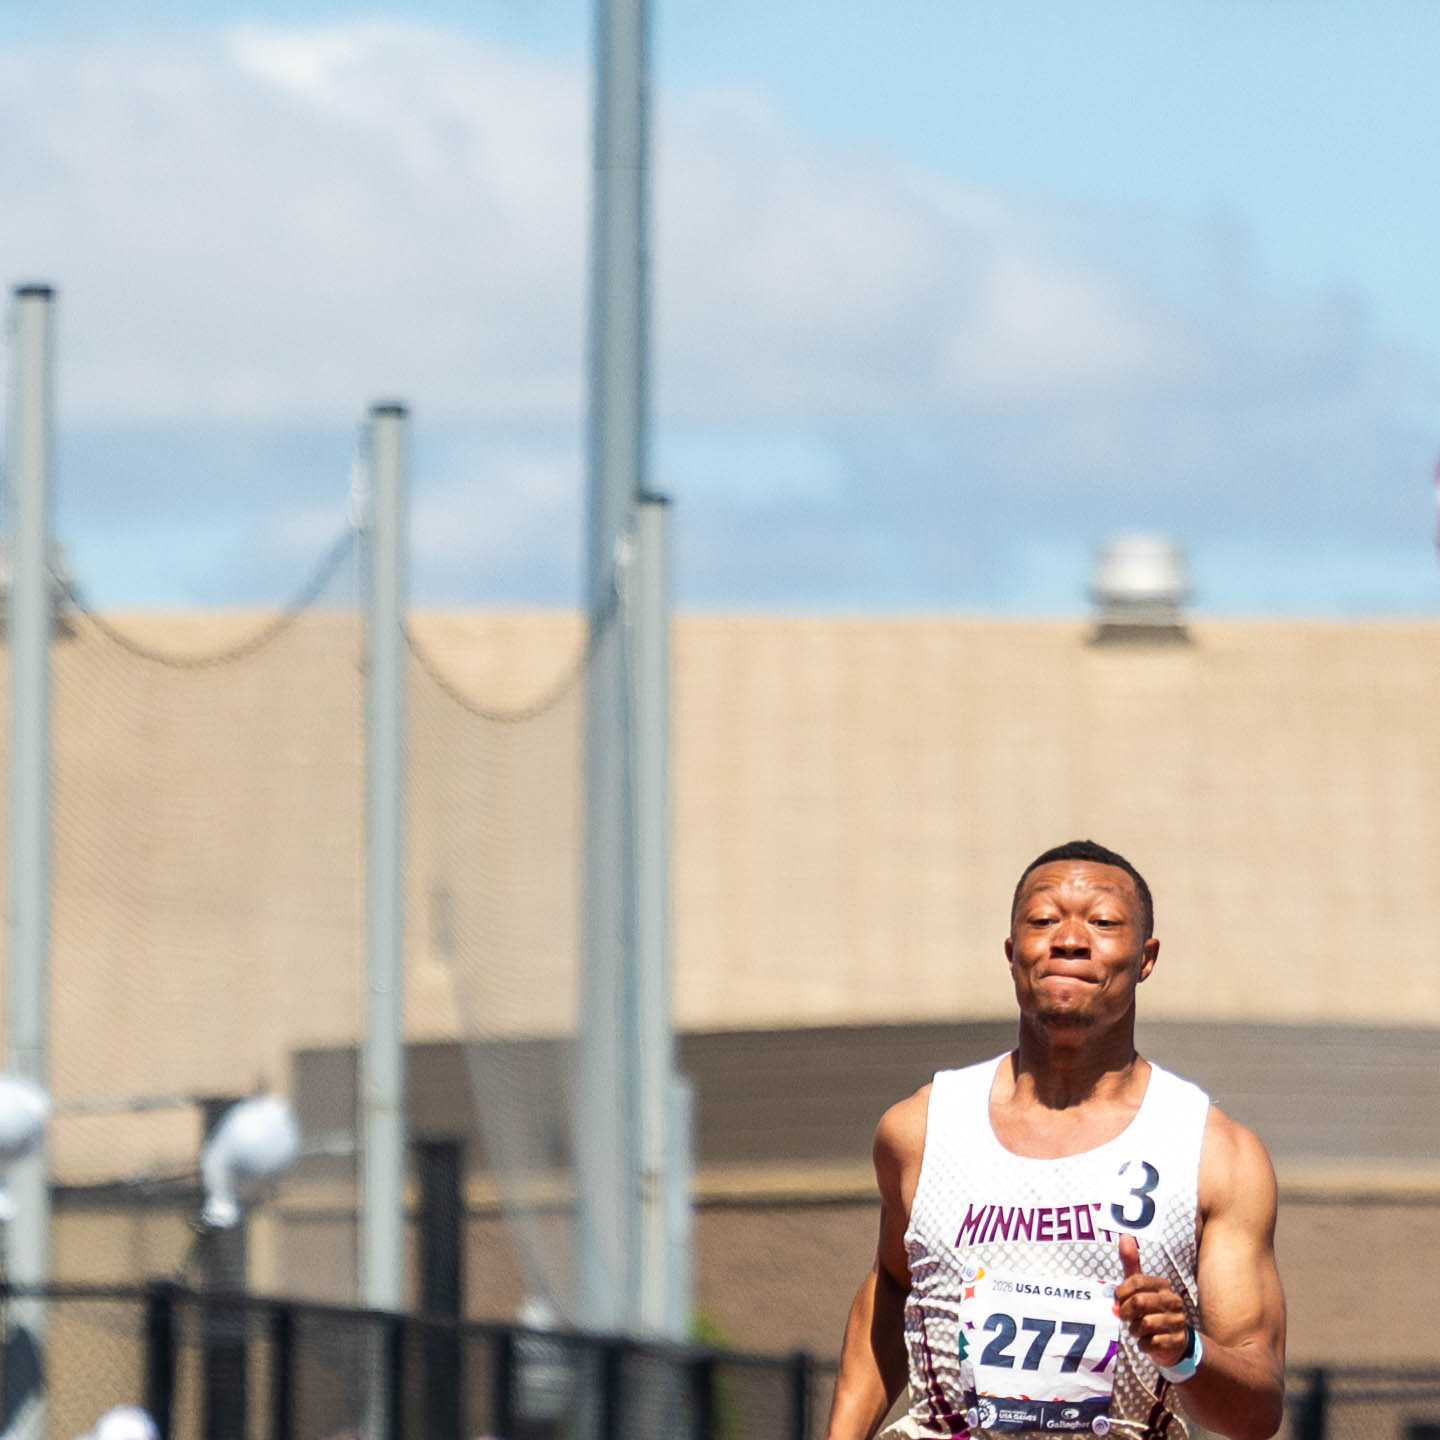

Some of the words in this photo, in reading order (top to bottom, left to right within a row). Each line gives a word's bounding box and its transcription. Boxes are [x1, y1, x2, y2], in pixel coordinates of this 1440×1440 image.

[1110, 1160, 1160, 1230] 3
[954, 1203, 1140, 1249] MINNESO
[1015, 1283, 1041, 1295] USA
[1044, 1286, 1092, 1300] GAMES
[980, 1312, 1096, 1373] 277
